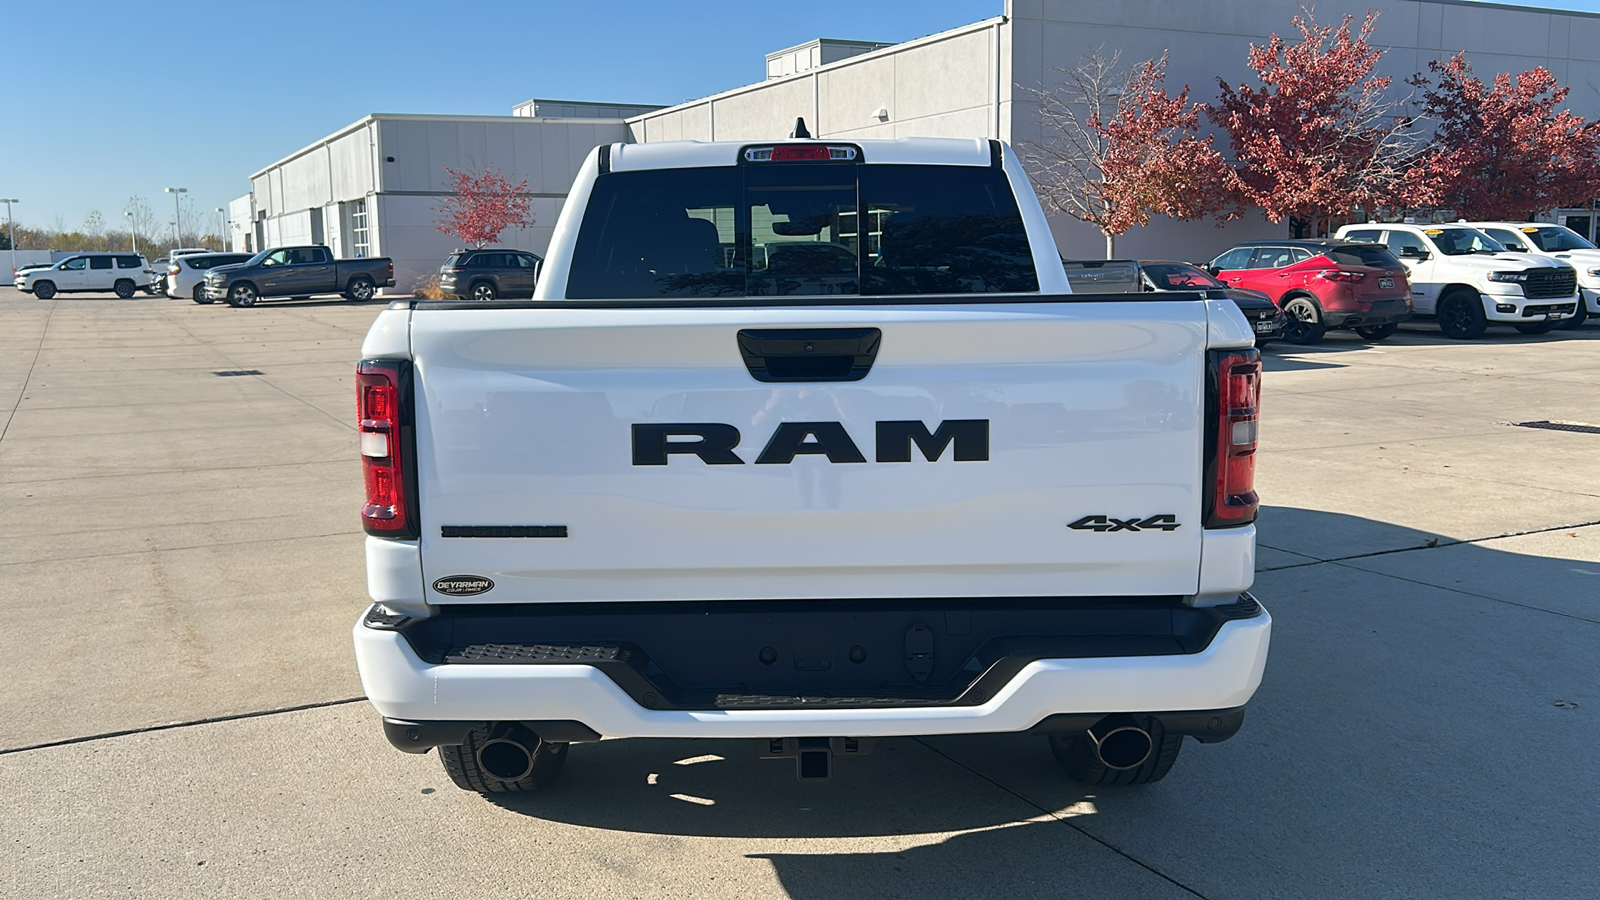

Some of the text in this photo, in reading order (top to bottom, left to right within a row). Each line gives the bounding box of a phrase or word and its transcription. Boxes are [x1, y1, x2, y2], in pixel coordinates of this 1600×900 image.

[631, 418, 990, 466] RAM
[1066, 514, 1182, 532] 4x4
[436, 580, 489, 589] DEYARMAN
